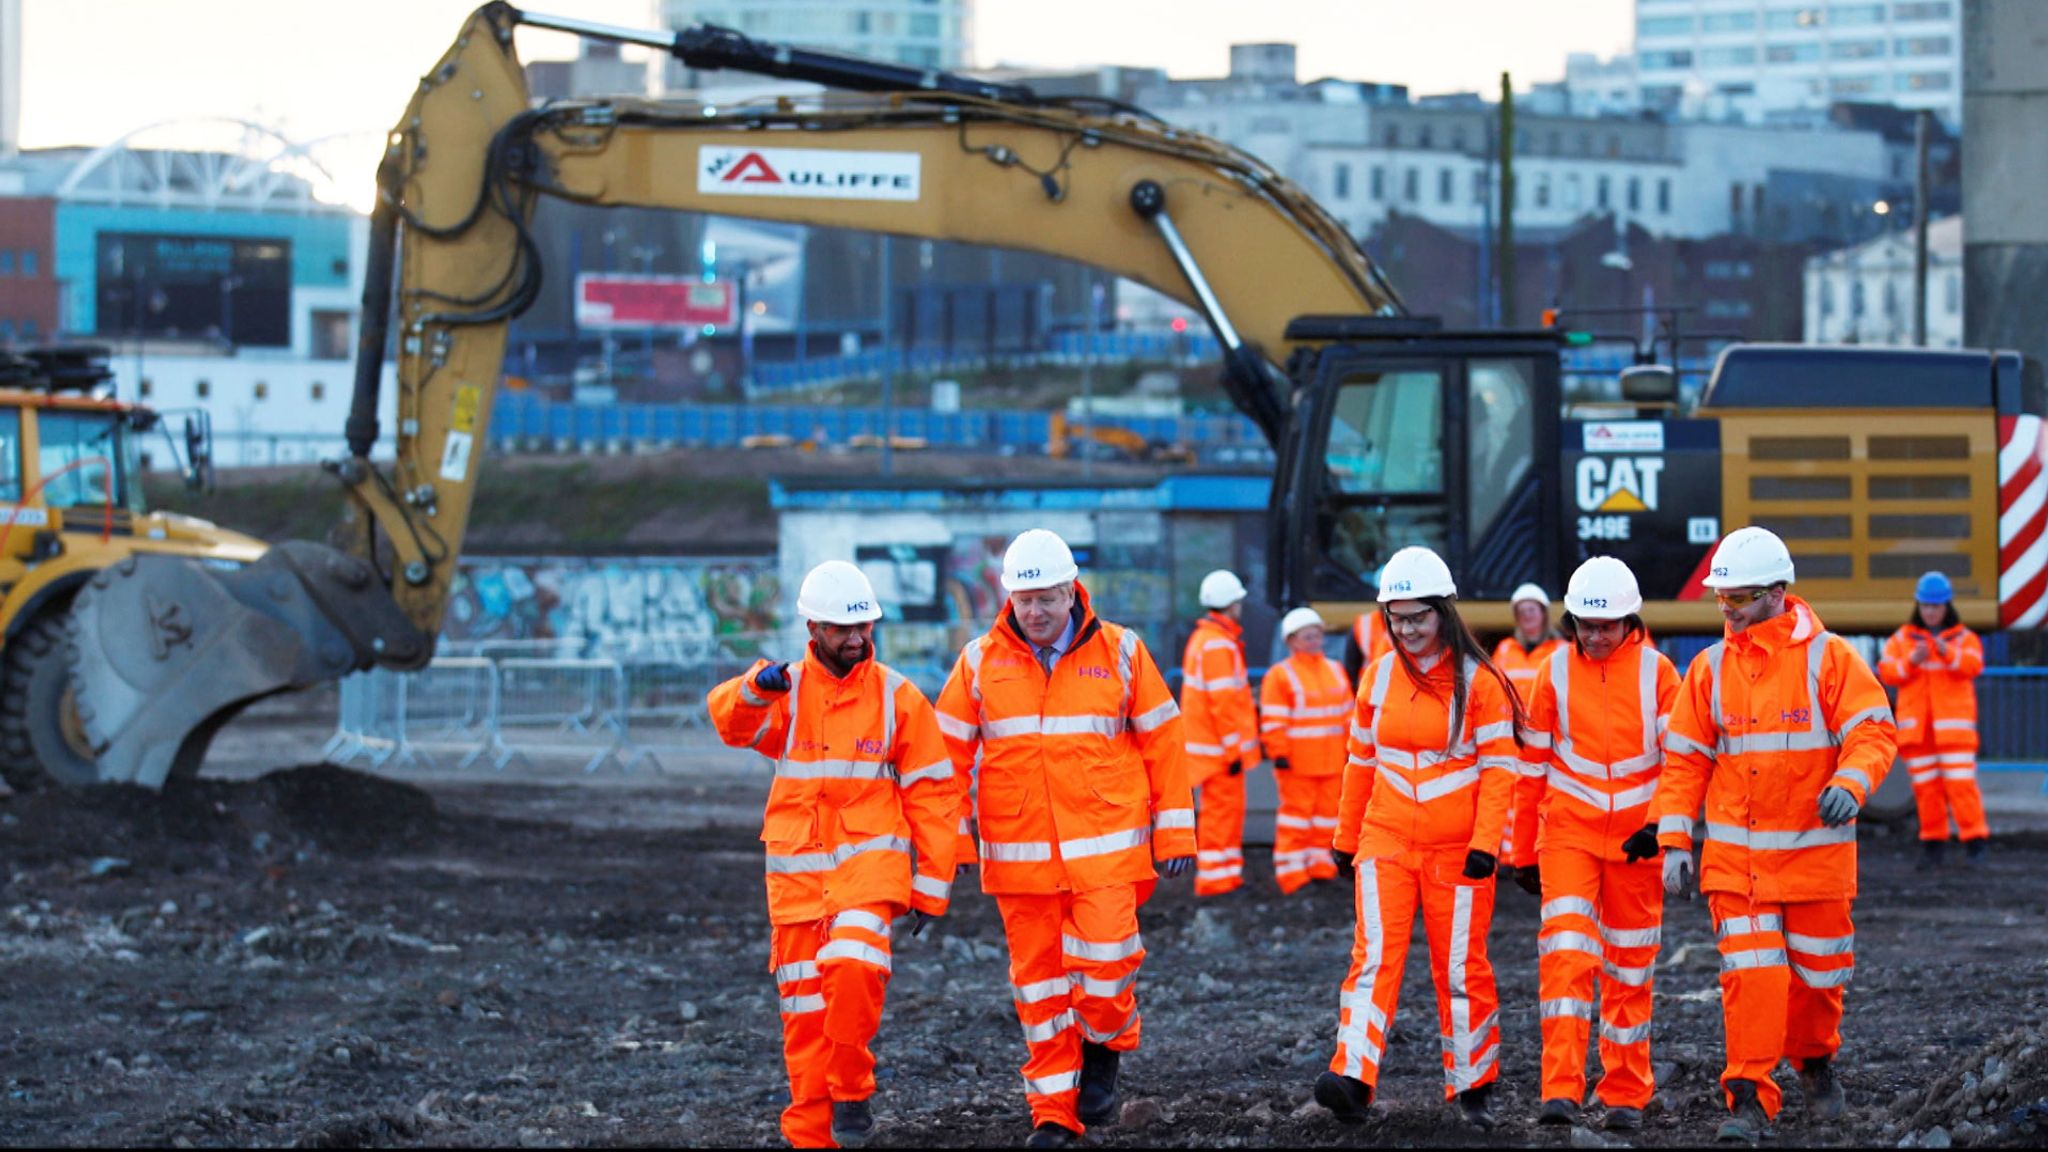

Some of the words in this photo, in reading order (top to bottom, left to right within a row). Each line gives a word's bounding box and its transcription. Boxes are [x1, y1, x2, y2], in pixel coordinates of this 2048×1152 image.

[1576, 457, 1665, 511] CAT
[1577, 516, 1631, 540] 349E
[1016, 568, 1041, 580] HS2
[847, 601, 869, 613] HS2
[1583, 597, 1608, 608] HS2
[1079, 666, 1111, 680] HS2
[1781, 708, 1809, 723] HS2
[856, 738, 883, 754] HS2
